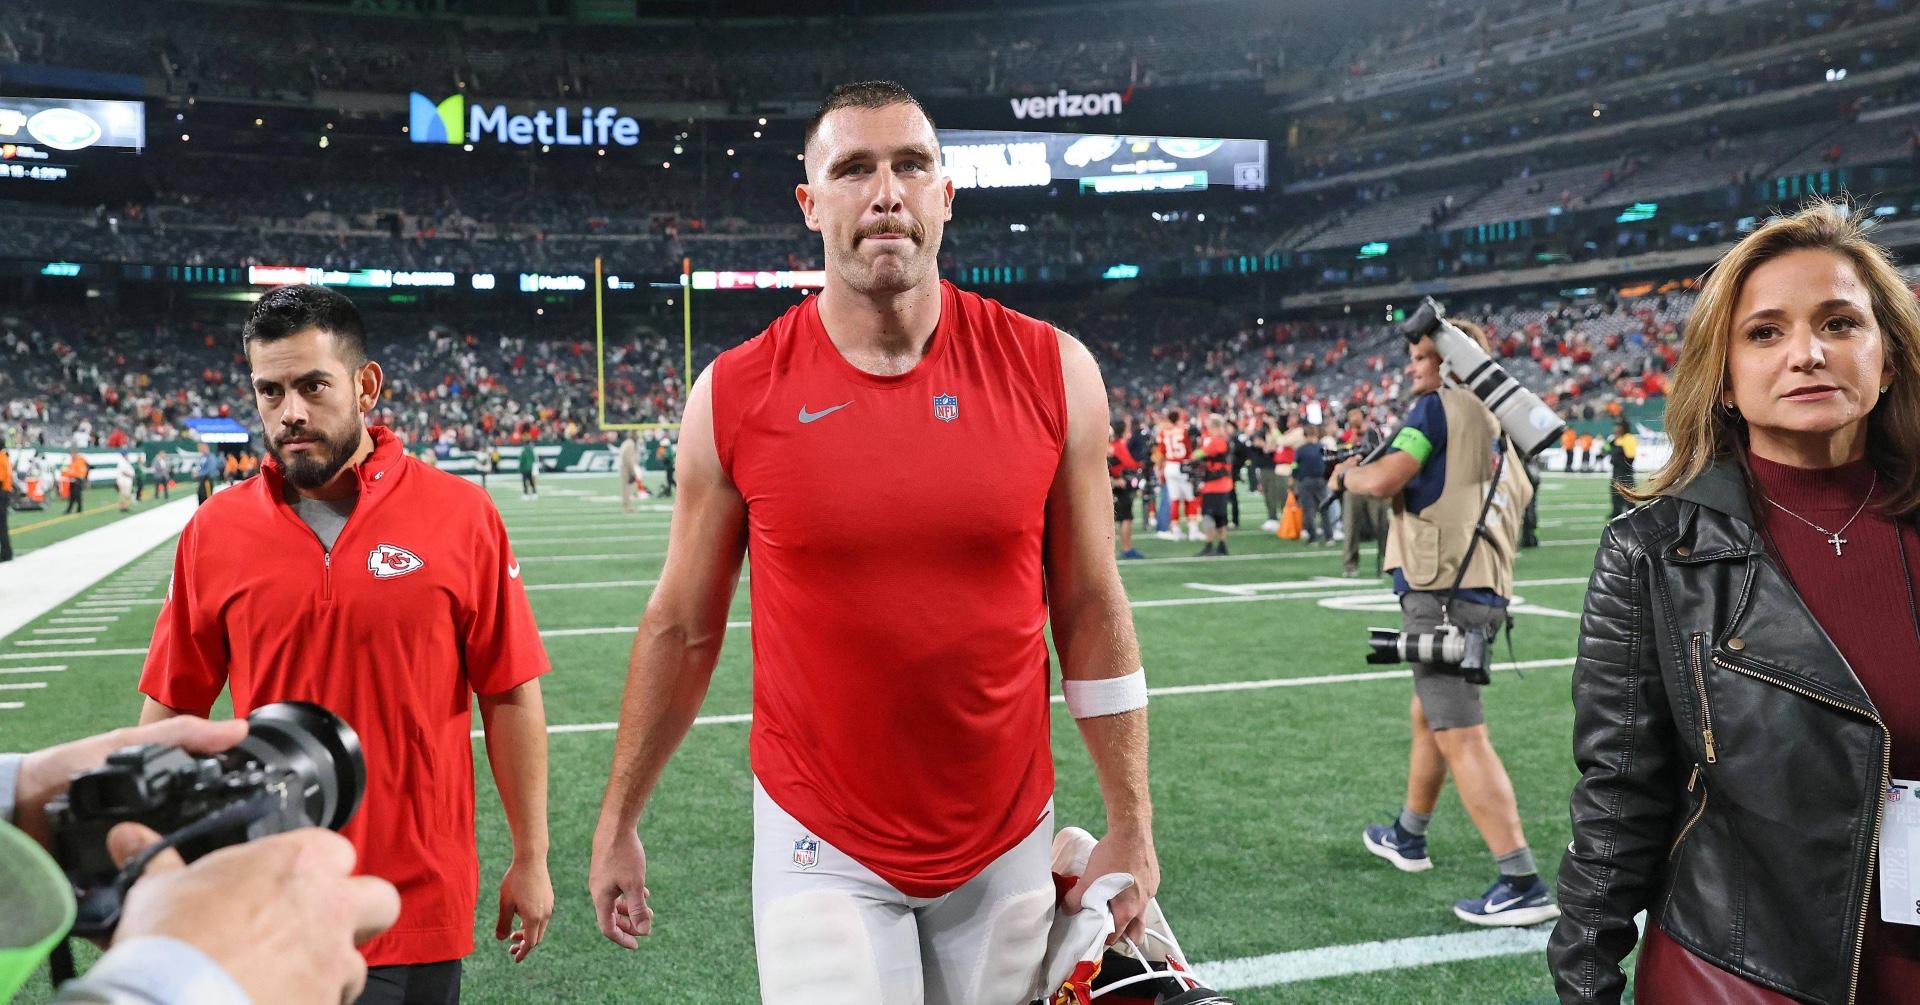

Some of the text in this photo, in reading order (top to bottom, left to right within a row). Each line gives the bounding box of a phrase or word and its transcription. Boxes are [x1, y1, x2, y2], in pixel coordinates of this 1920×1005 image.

[1010, 89, 1122, 119] verizon
[470, 104, 640, 146] MetLife
[1164, 435, 1187, 459] 15
